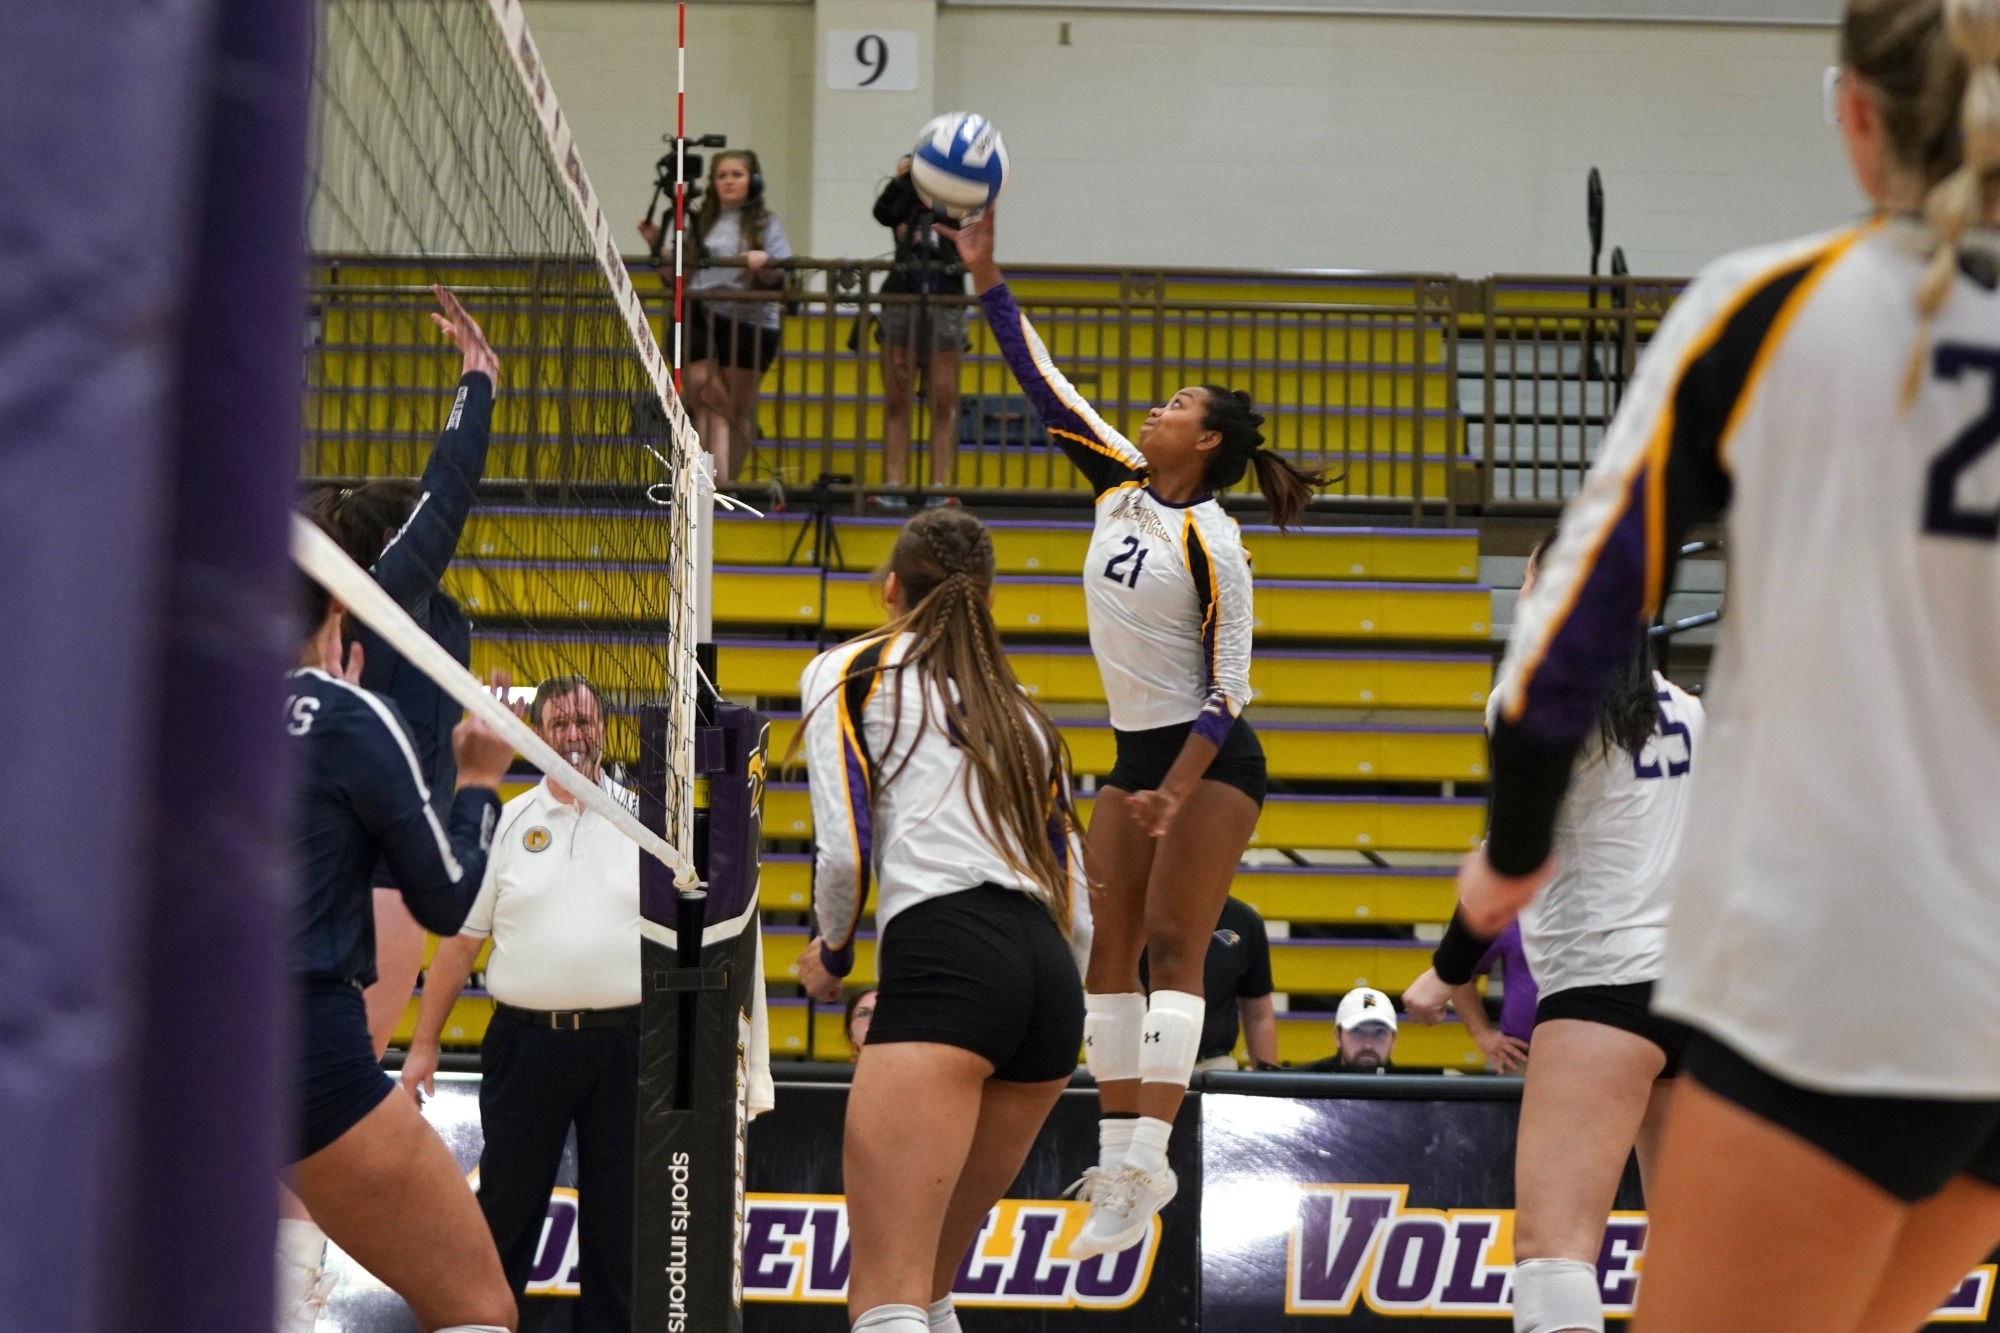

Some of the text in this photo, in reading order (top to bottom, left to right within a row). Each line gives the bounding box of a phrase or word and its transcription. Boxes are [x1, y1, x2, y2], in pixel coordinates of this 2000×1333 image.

[856, 34, 888, 86] 9
[1103, 535, 1149, 589] 21
[668, 1151, 691, 1231] sports
